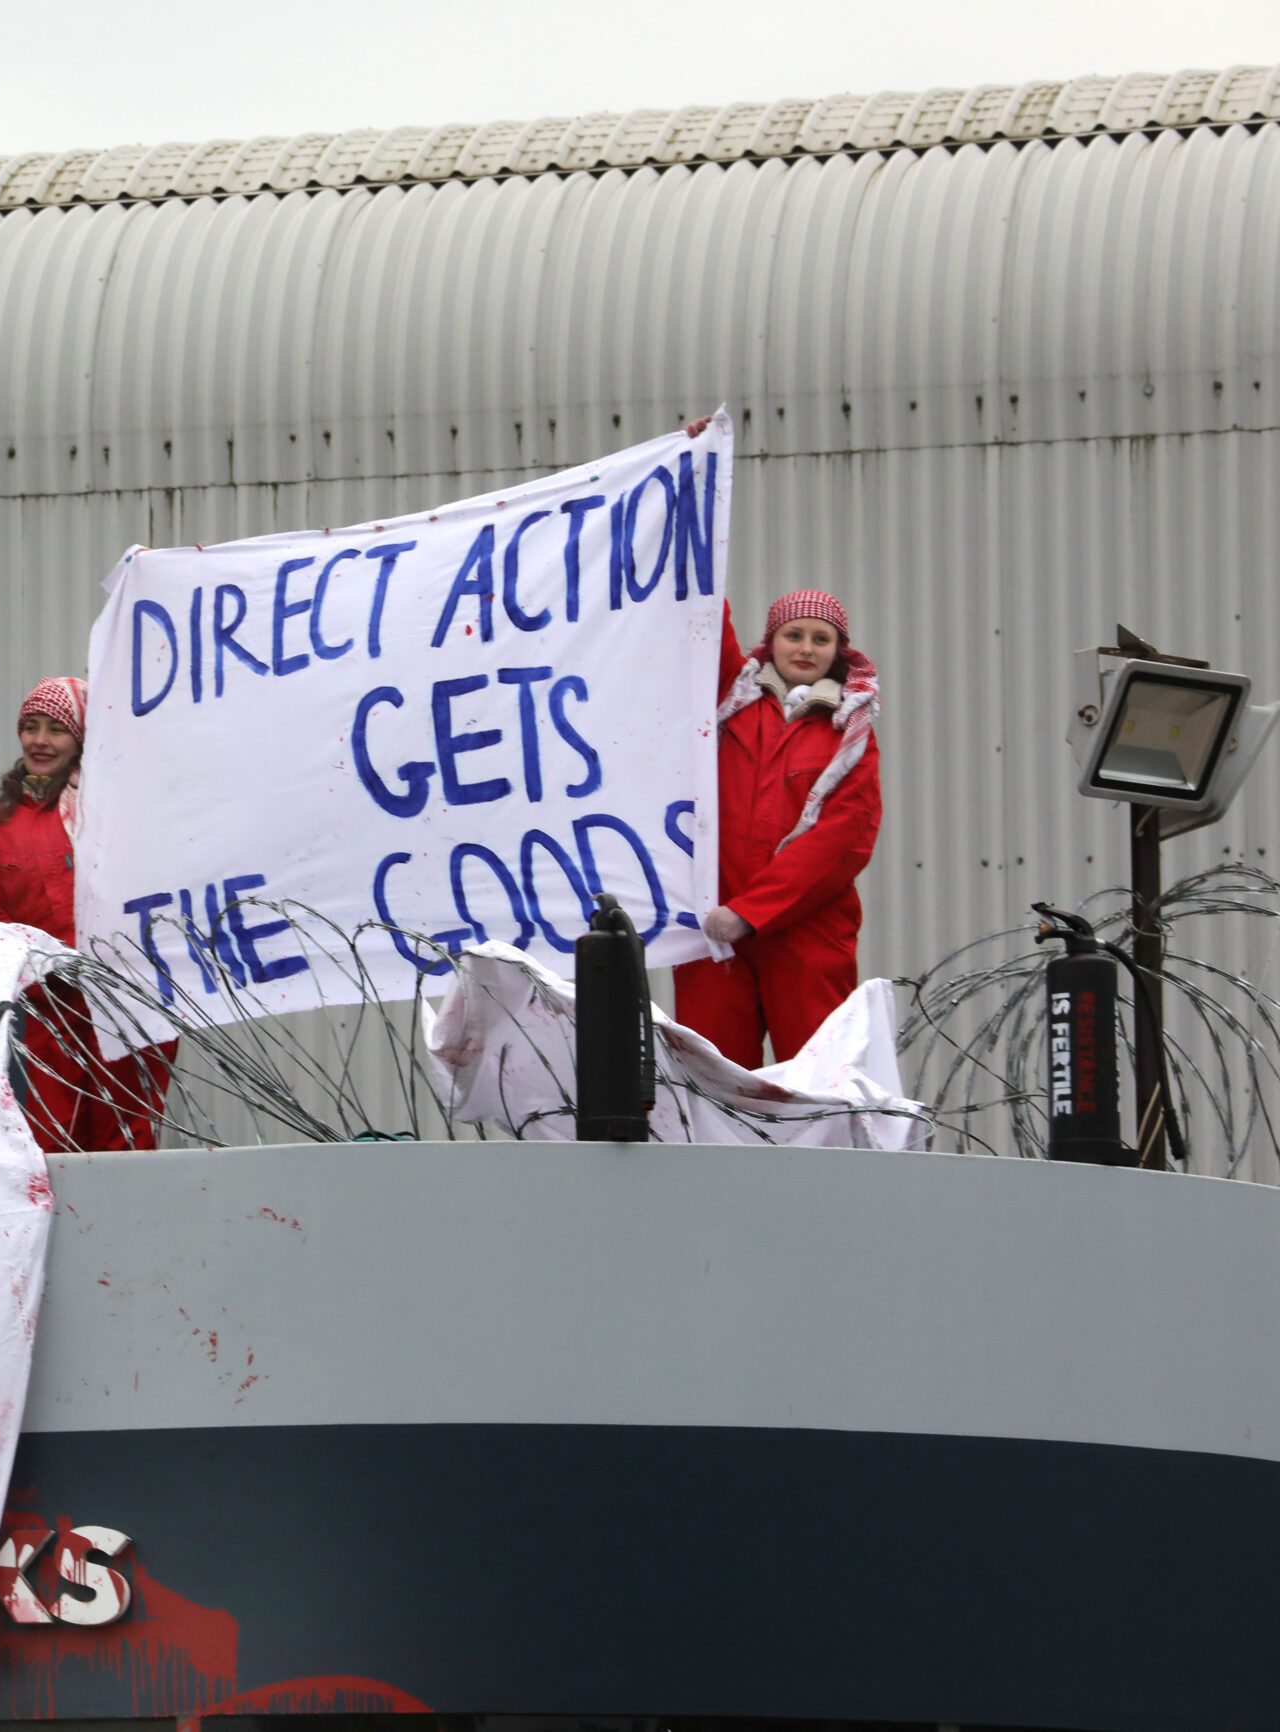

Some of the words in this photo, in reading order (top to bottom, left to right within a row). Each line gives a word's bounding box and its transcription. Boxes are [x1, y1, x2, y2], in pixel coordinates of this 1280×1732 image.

[131, 540, 417, 717] DIRECT
[431, 450, 718, 648] ACTION
[351, 665, 603, 819] GETS
[124, 873, 311, 1007] THE
[373, 800, 701, 977] GOODS
[1051, 991, 1071, 1016] IS
[1051, 1022, 1073, 1117] FERTILE
[1075, 991, 1097, 1114] RESISTANCE
